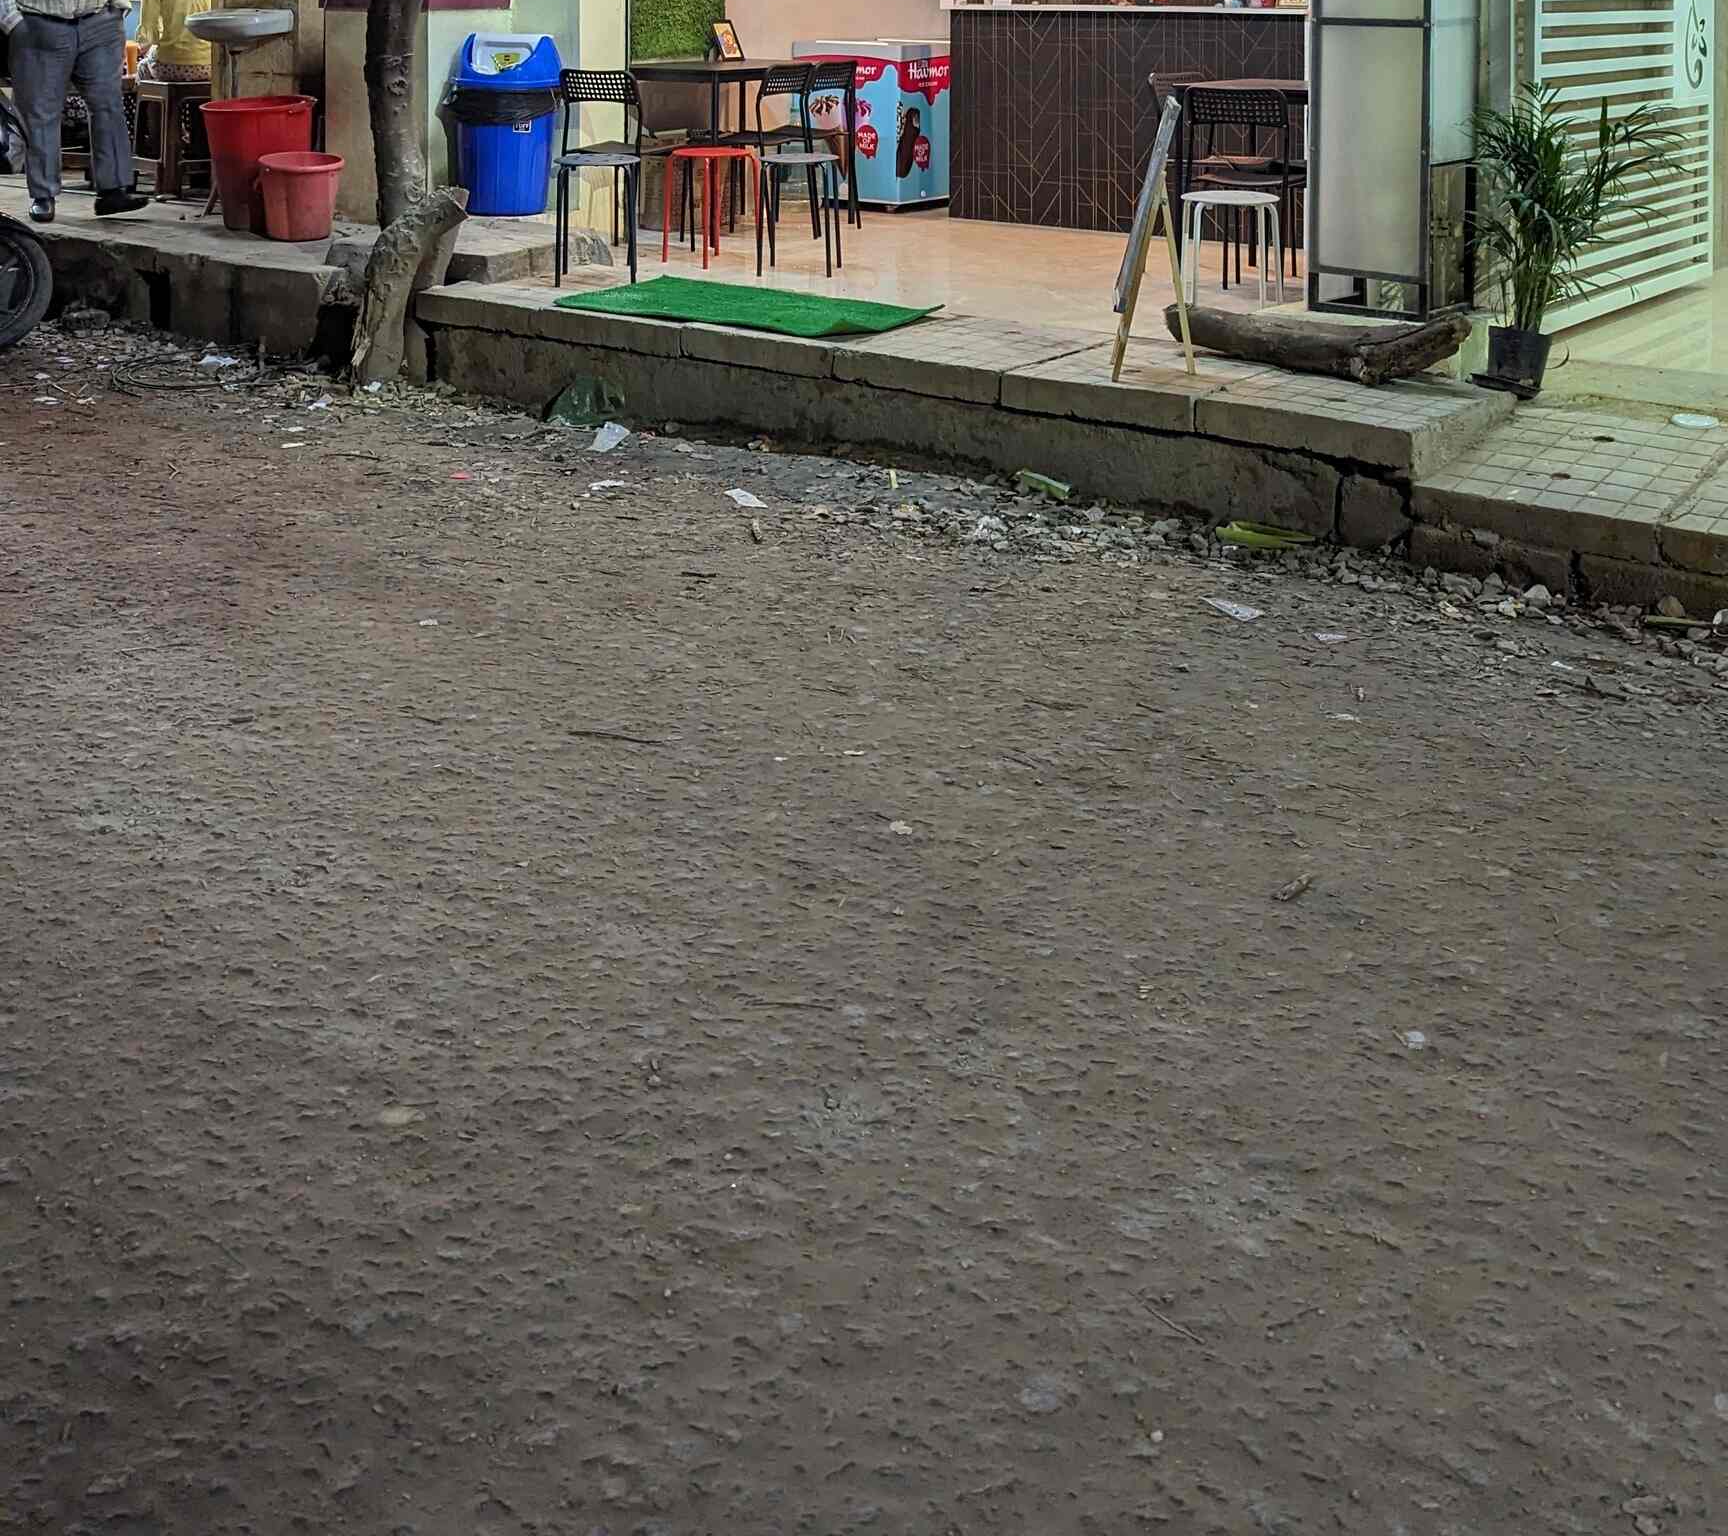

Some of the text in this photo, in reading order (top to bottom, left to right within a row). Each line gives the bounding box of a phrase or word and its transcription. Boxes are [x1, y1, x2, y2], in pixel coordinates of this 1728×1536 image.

[855, 65, 877, 75] mor
[907, 61, 949, 81] Havmor
[857, 131, 876, 140] MADE
